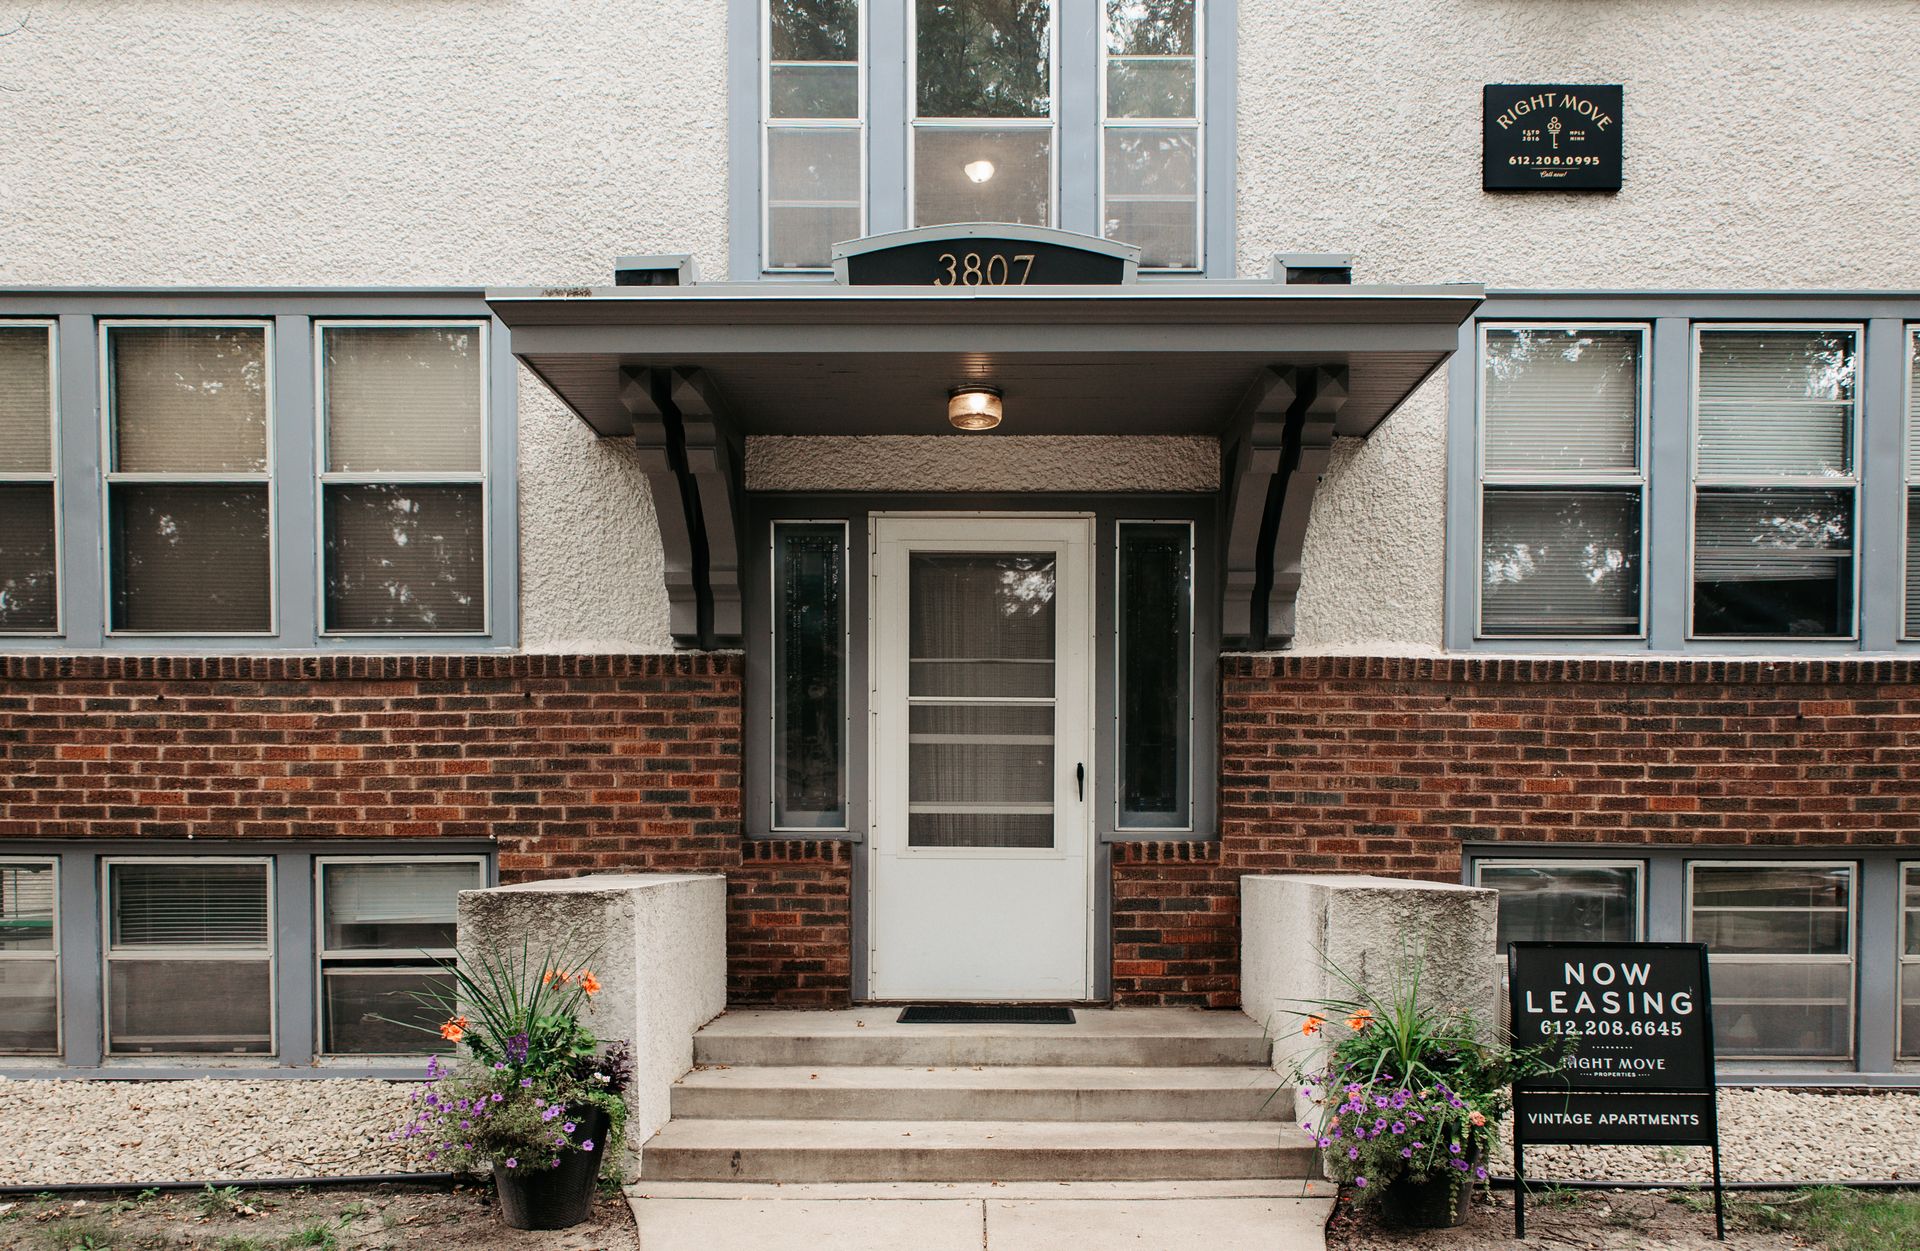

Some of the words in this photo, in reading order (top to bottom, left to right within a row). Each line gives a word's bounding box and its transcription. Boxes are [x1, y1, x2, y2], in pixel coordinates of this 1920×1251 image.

[1496, 92, 1557, 130] RIGHT
[1559, 94, 1613, 131] MOVE
[1508, 156, 1600, 166] 612.208.0995
[933, 252, 1036, 286] 3807
[1564, 962, 1651, 986] NOW
[1526, 990, 1693, 1015] LEASING
[1540, 1020, 1683, 1037] 612.208.6645
[1618, 1058, 1666, 1070] MOVE
[1527, 1113, 1593, 1125] VINTAGE
[1598, 1113, 1700, 1126] APARTMENTS
